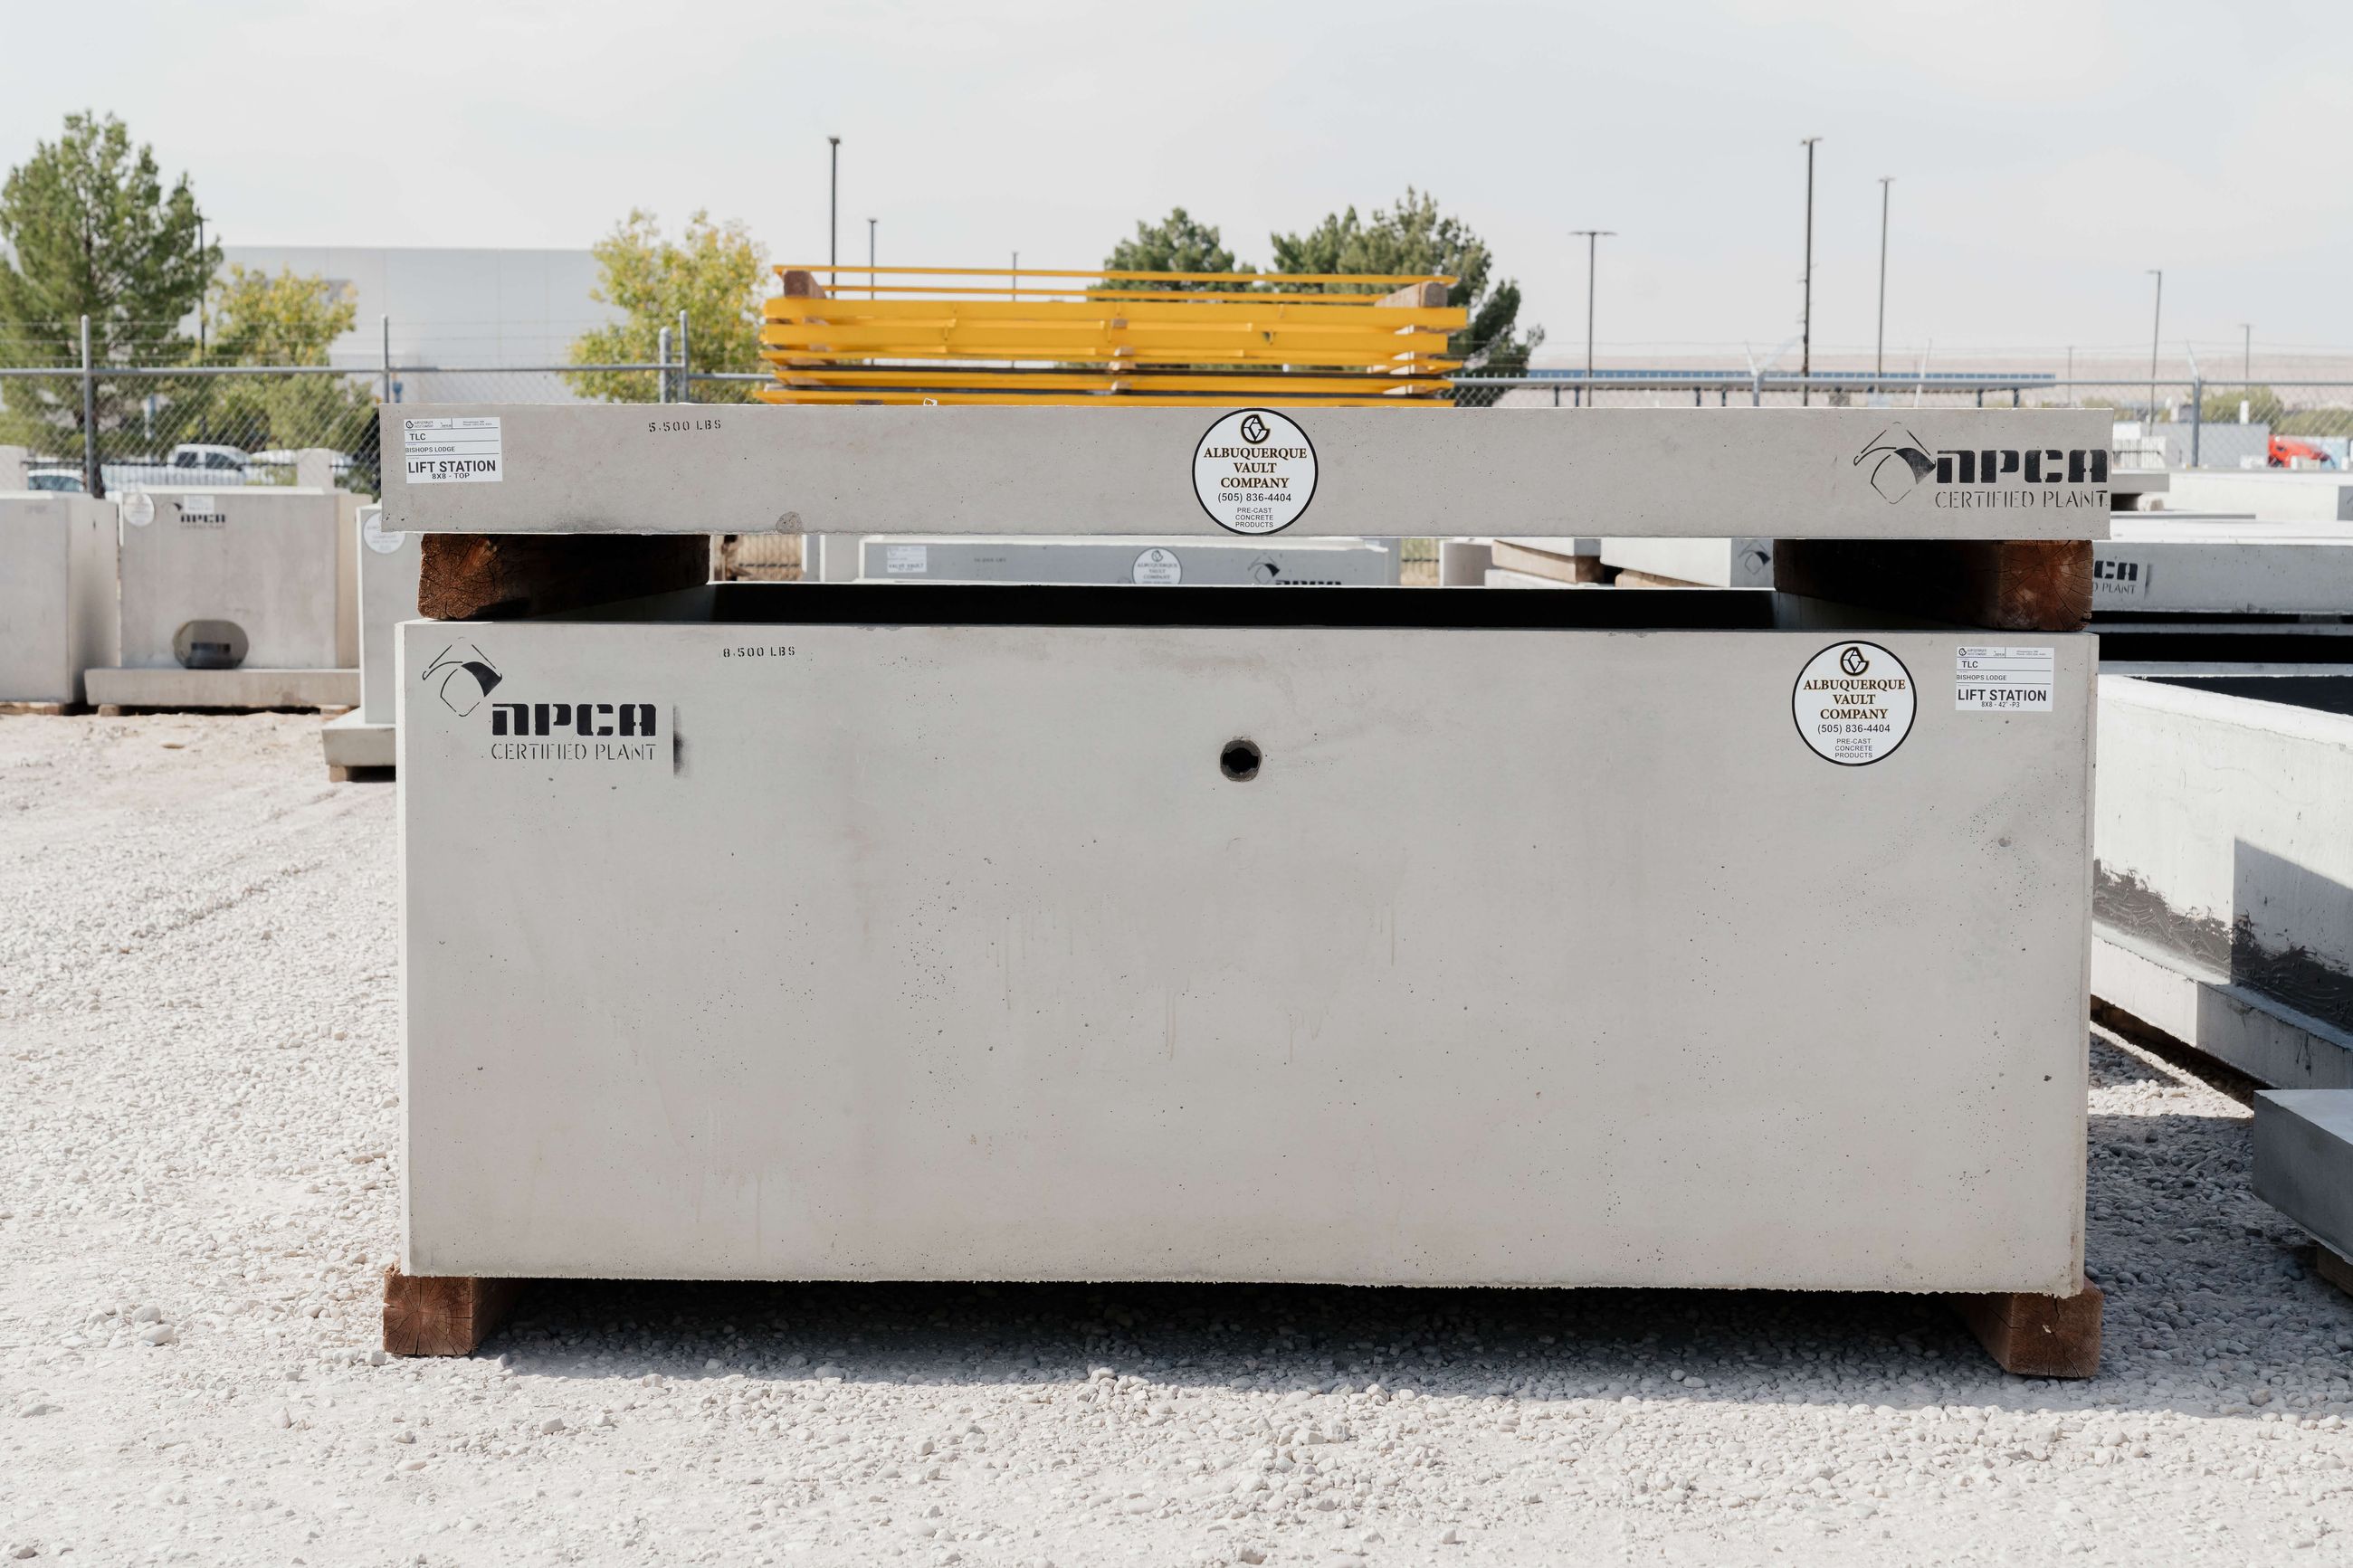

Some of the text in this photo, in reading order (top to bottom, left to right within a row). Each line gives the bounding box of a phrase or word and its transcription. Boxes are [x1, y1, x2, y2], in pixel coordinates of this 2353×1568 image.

[696, 419, 721, 431] LBS
[409, 432, 426, 441] TLC
[1204, 447, 1308, 461] ALBUQUERQUE
[408, 460, 496, 473] LIFT STATION
[1234, 462, 1277, 473] VAULT
[1220, 477, 1290, 489] COMPANY
[1218, 493, 1291, 503] (505) 836-4404
[1935, 491, 2034, 508] CERTIFIED
[2102, 583, 2136, 594] PLANT
[770, 646, 795, 657] LBS
[1962, 660, 1978, 669] TLC
[1804, 679, 1906, 692] ALBUQUERQUE
[1833, 694, 1876, 705] VAULT
[1958, 689, 2047, 701] LIFT STATION
[1820, 708, 1889, 720] COMPANY
[1817, 724, 1891, 735] (505) 836-4404
[491, 743, 657, 761] CERTIFIED PLANT
